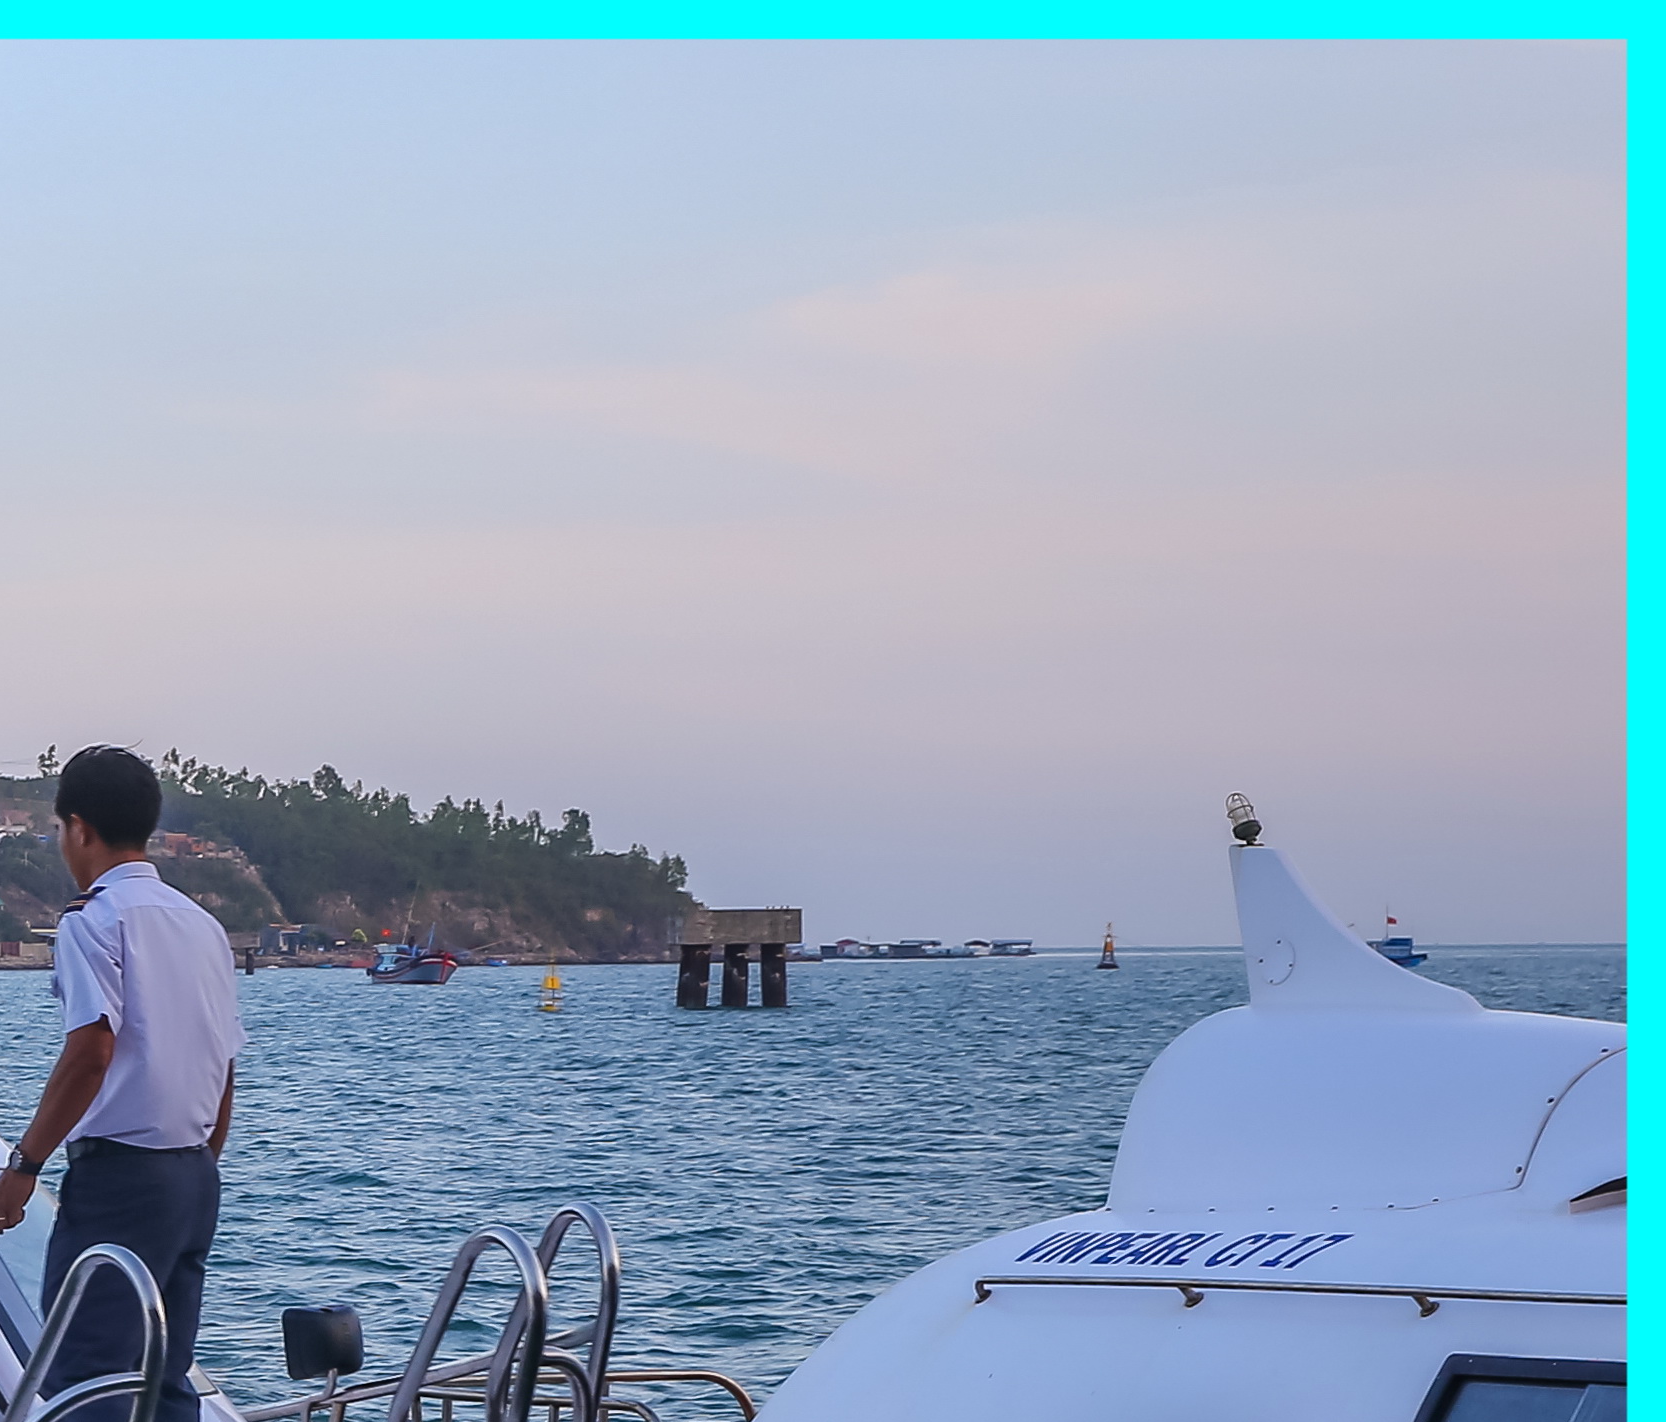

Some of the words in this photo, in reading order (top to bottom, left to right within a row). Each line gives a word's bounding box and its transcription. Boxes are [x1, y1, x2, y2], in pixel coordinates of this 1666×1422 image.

[1013, 1231, 1224, 1266] VINPEARL
[1204, 1232, 1296, 1268] CT
[1259, 1233, 1355, 1269] 17
